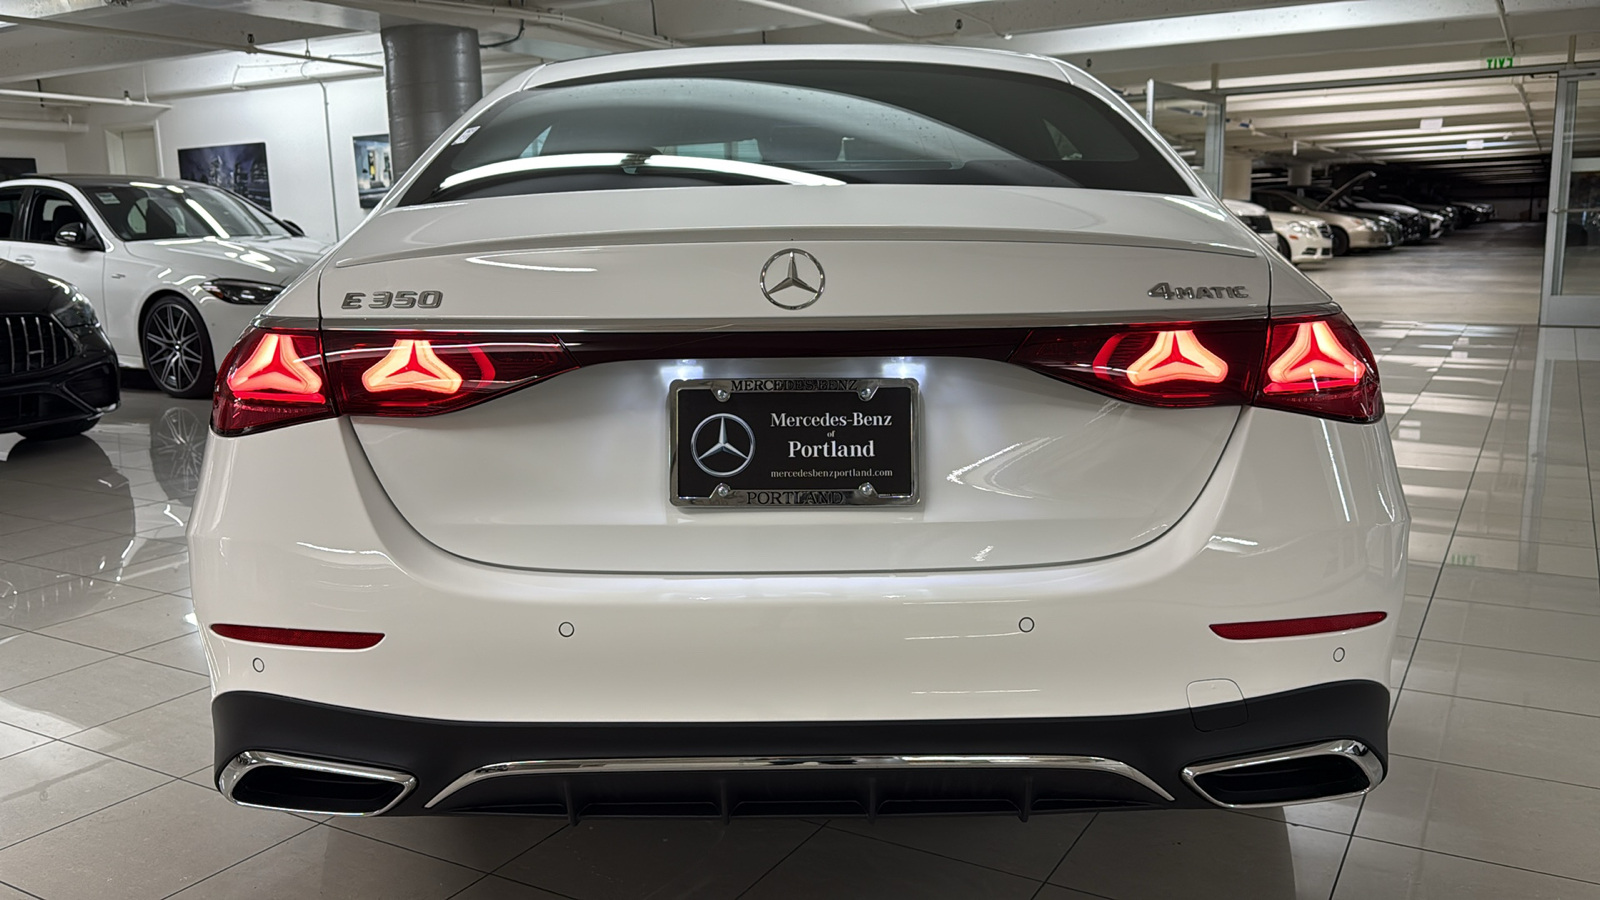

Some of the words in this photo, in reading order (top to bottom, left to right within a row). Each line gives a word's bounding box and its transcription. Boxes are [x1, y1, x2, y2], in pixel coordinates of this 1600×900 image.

[1147, 282, 1249, 299] 4MATIC
[341, 292, 366, 309] E
[368, 290, 444, 309] 350
[770, 412, 892, 427] Mercedes-Benz
[788, 440, 875, 457] Portland
[770, 468, 893, 478] mercedesbenzportland.com
[746, 491, 844, 504] PORTLAND
